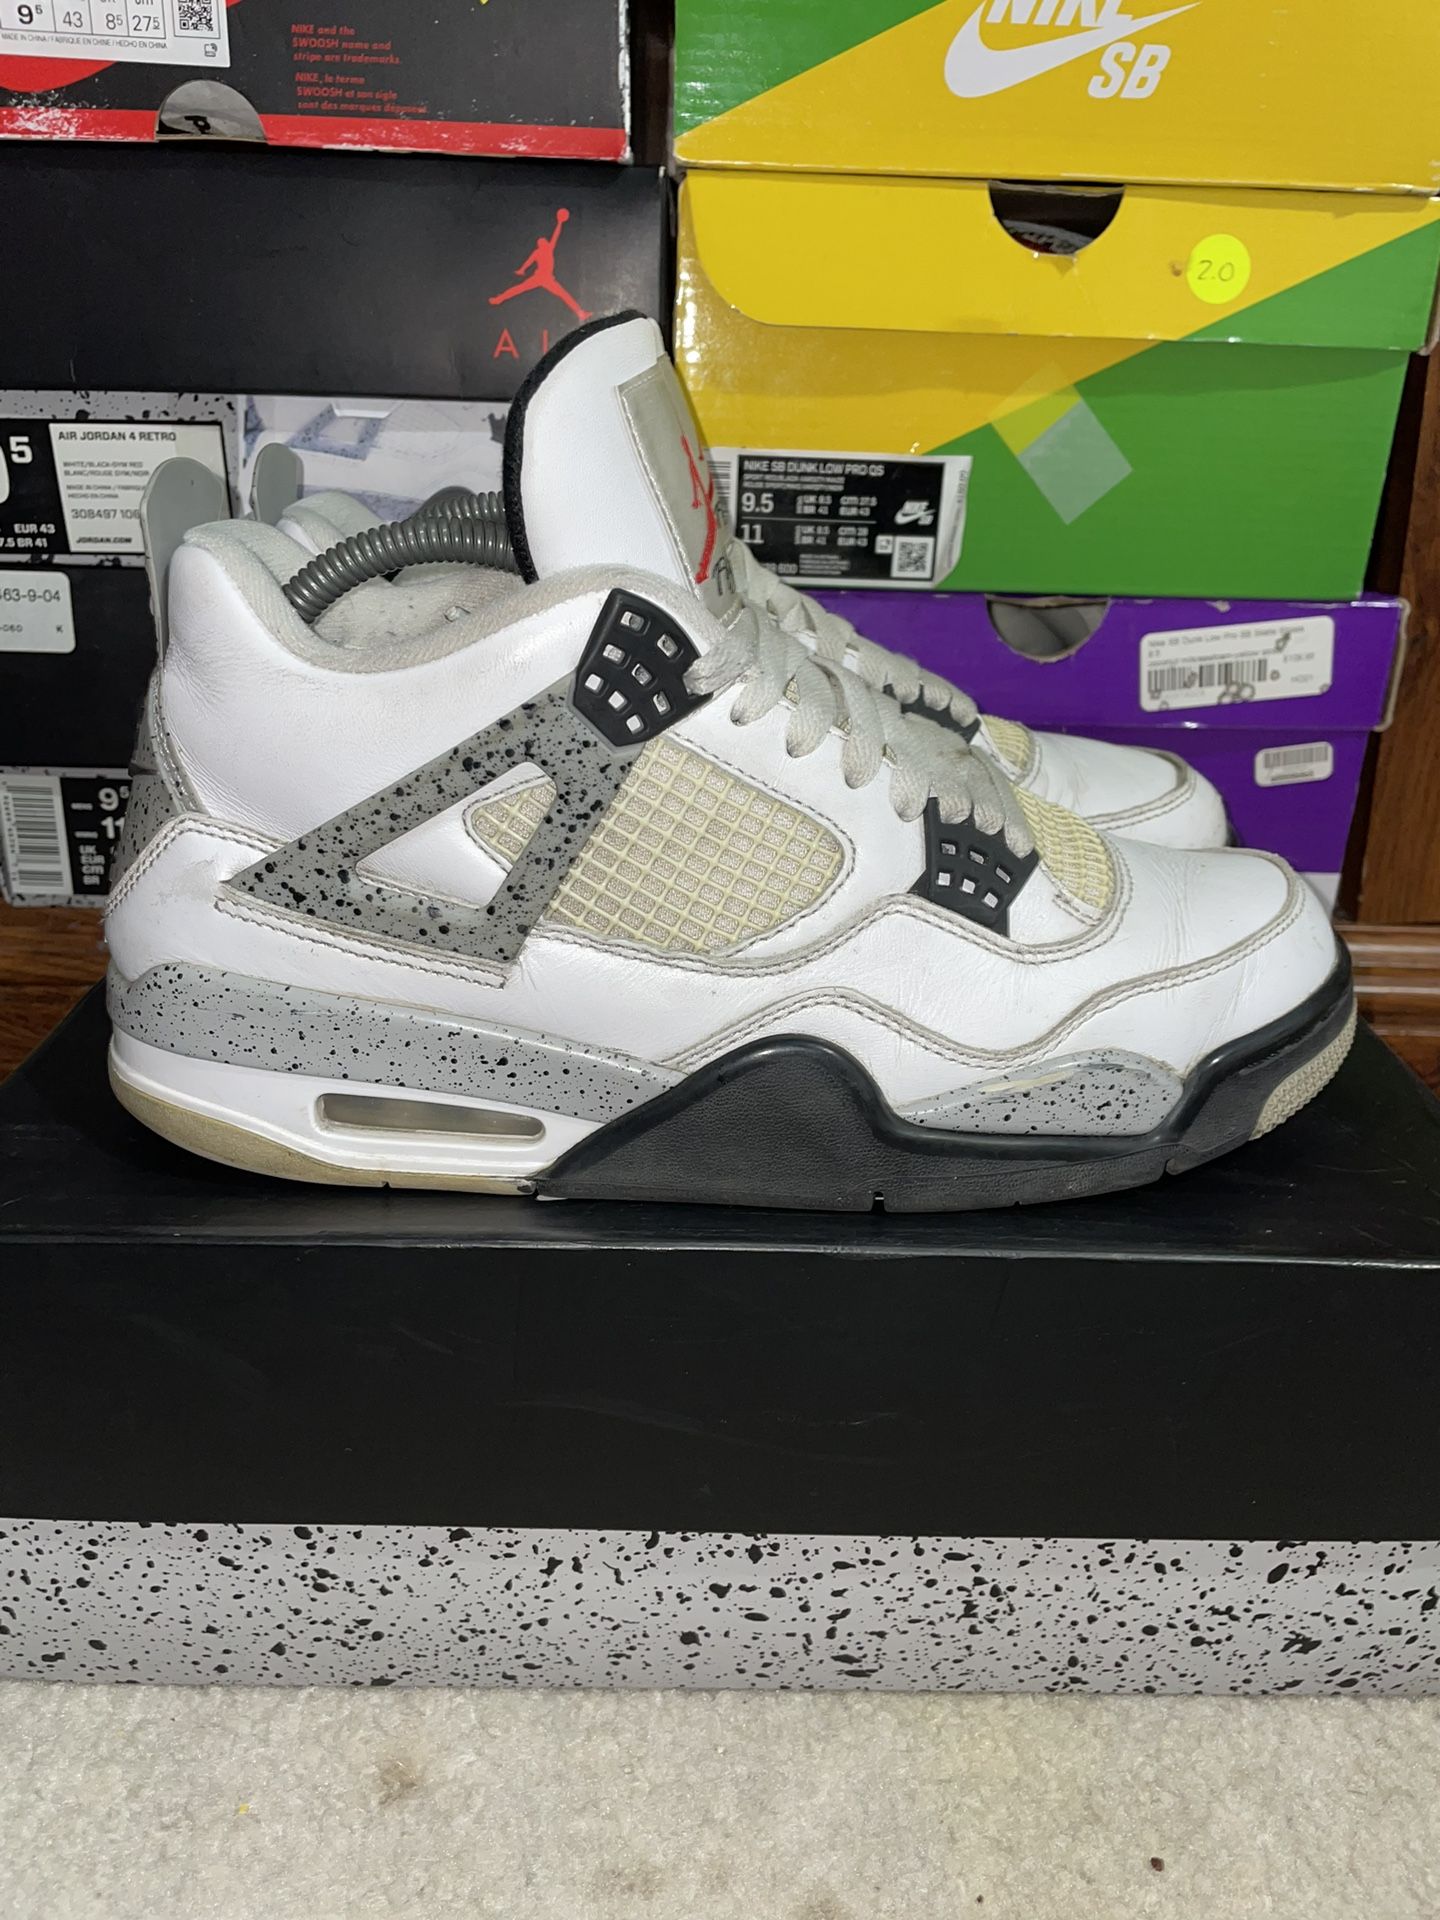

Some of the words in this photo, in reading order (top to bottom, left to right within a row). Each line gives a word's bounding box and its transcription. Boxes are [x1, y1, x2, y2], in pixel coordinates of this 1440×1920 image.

[62, 11, 83, 28] 43
[291, 24, 314, 34] NIKE
[317, 25, 337, 35] and
[339, 25, 356, 35] the
[1, 32, 19, 40] MADE
[28, 34, 47, 42] CHINA
[116, 40, 138, 48] HECHO
[292, 37, 339, 48] SWOOSH
[341, 41, 369, 49] name
[371, 41, 392, 50] and
[1087, 42, 1171, 99] SB
[297, 86, 343, 97] SWOOSH
[1196, 259, 1235, 282] 2.0
[493, 327, 549, 359] AI
[58, 431, 77, 440] AIR
[80, 431, 126, 441] JORDAN
[129, 431, 137, 441] 4
[138, 431, 177, 441] RETRO
[743, 460, 770, 471] NIKE
[770, 461, 786, 472] SB
[786, 462, 818, 473] DUNK
[818, 463, 844, 474] LOW
[844, 464, 868, 475] PRO
[868, 465, 885, 477] QS
[741, 492, 775, 513] 9.5
[71, 508, 117, 520] 308497
[14, 523, 38, 534] EUR
[39, 523, 56, 534] 43
[741, 523, 765, 544] 11
[17, 537, 33, 548] BR
[34, 537, 48, 548] 41
[76, 536, 132, 544] JORDAN.COM
[79, 844, 98, 855] UK
[80, 855, 105, 865] EUR
[83, 875, 100, 886] BR
